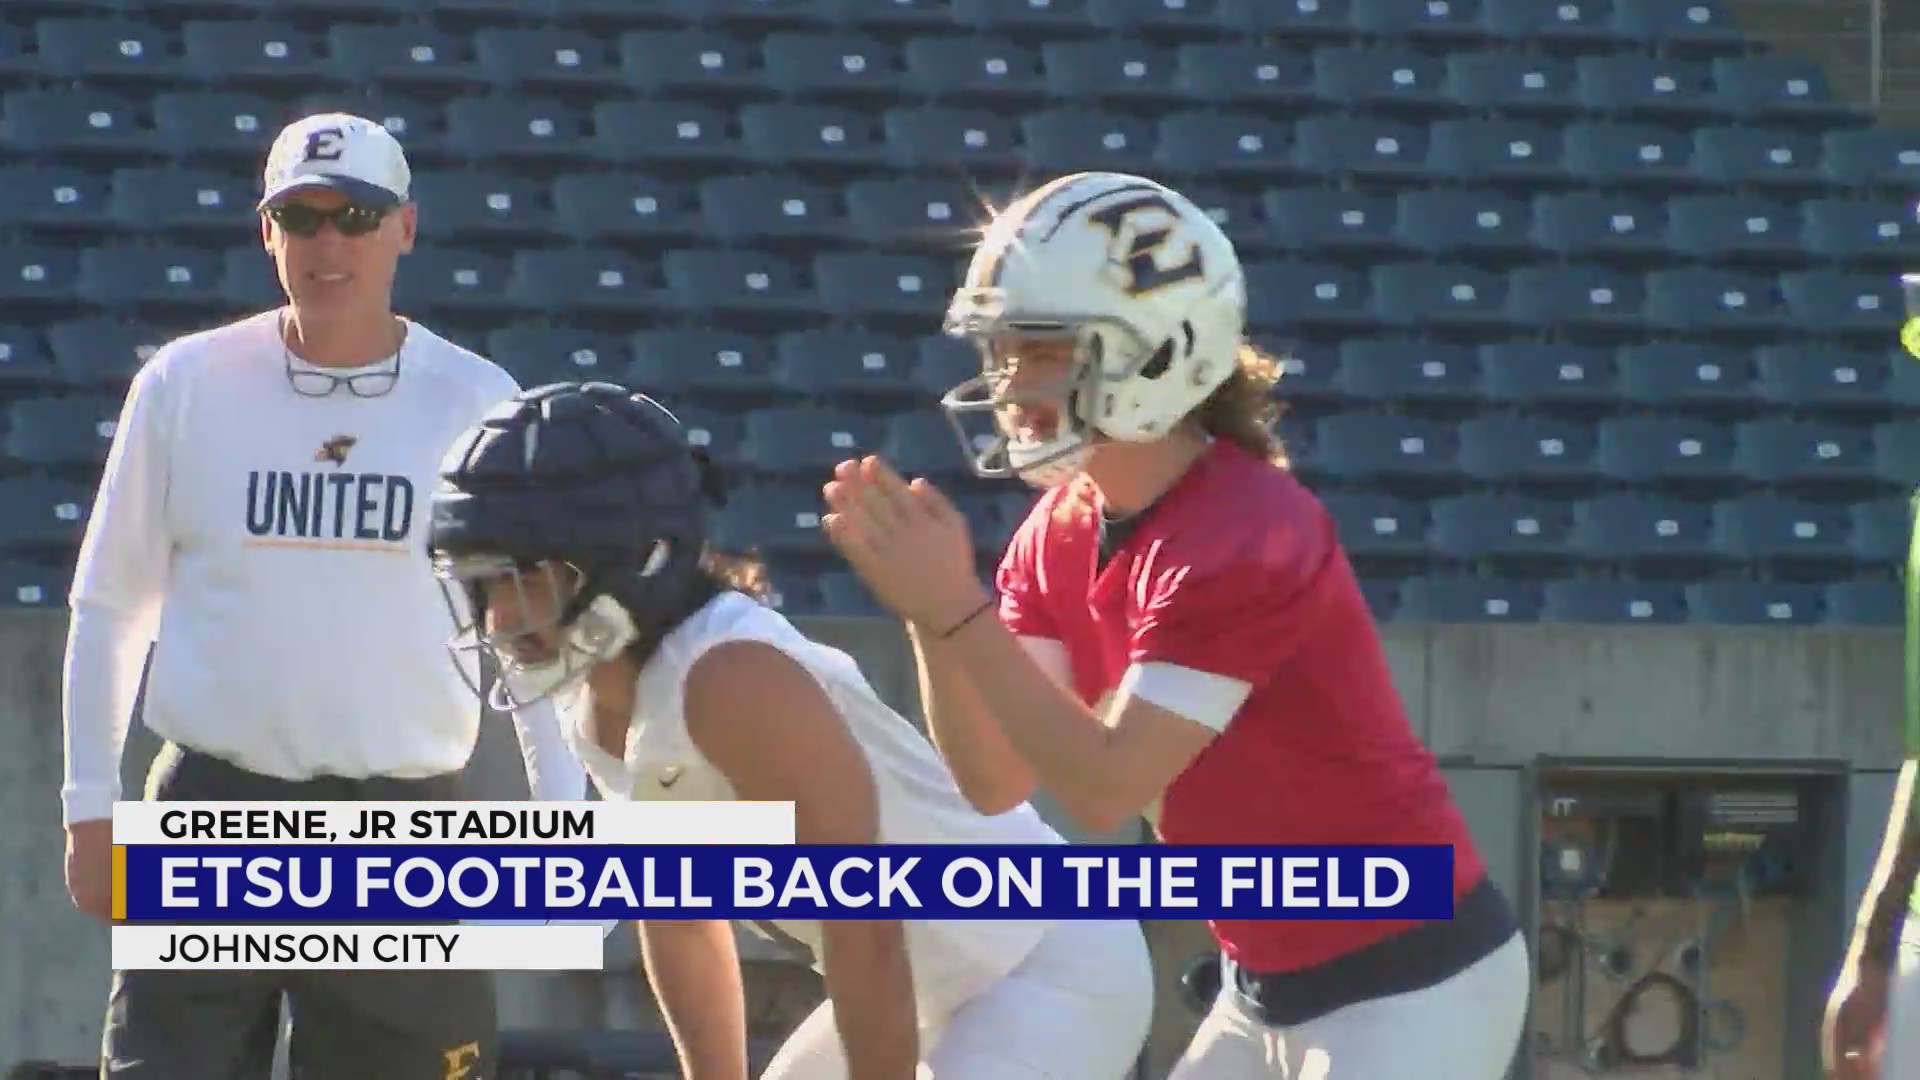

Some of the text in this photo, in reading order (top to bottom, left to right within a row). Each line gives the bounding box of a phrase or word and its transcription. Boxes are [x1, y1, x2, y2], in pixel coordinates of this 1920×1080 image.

[304, 128, 345, 162] E
[1088, 195, 1205, 296] E
[246, 470, 414, 542] UNITED
